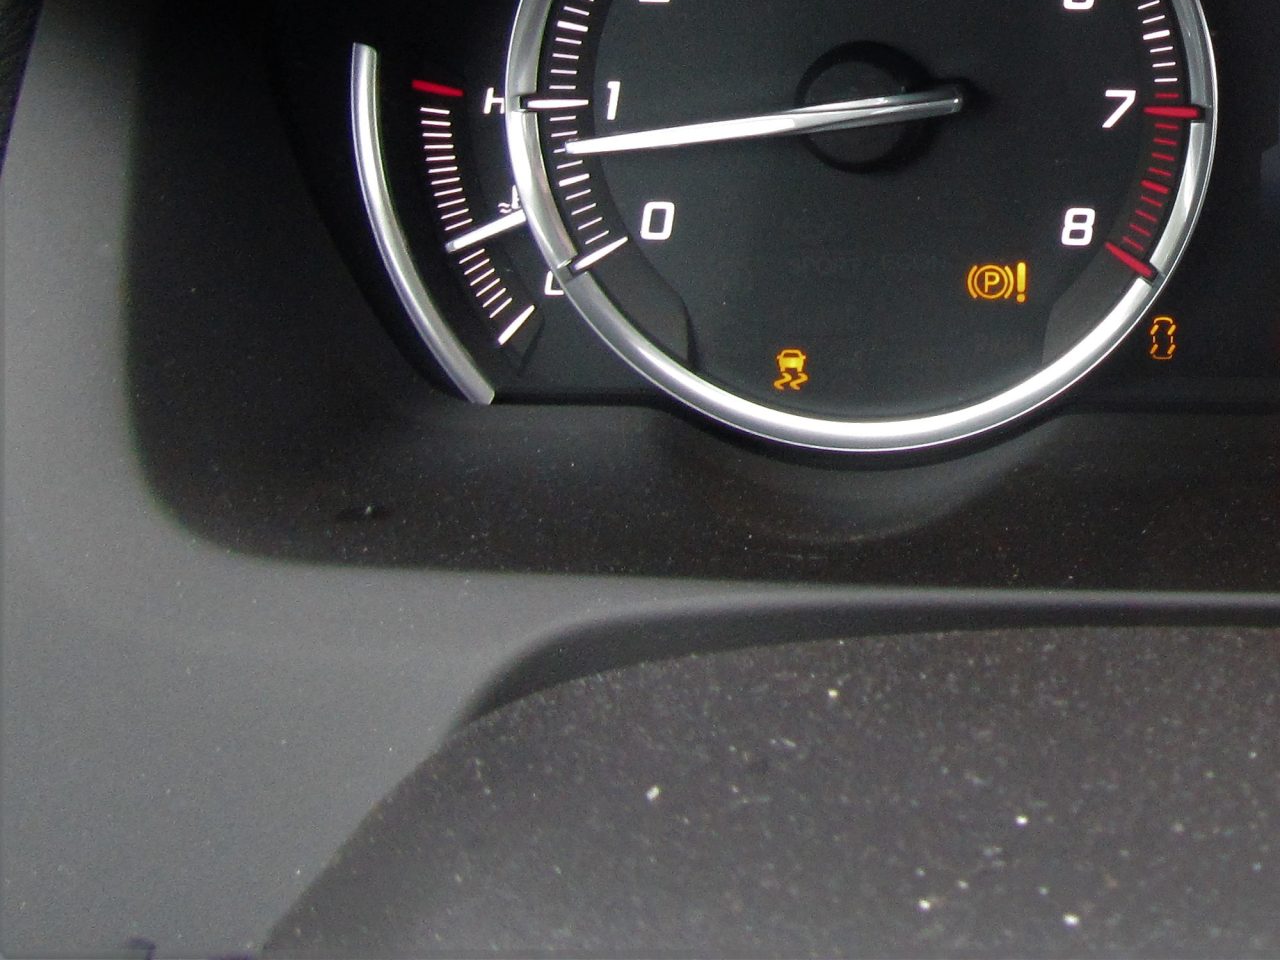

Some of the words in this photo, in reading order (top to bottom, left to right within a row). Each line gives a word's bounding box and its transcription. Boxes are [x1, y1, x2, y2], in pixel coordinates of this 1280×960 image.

[606, 80, 621, 121] 1
[1101, 89, 1137, 129] 7
[639, 201, 675, 241] 0
[1061, 207, 1096, 246] 8
